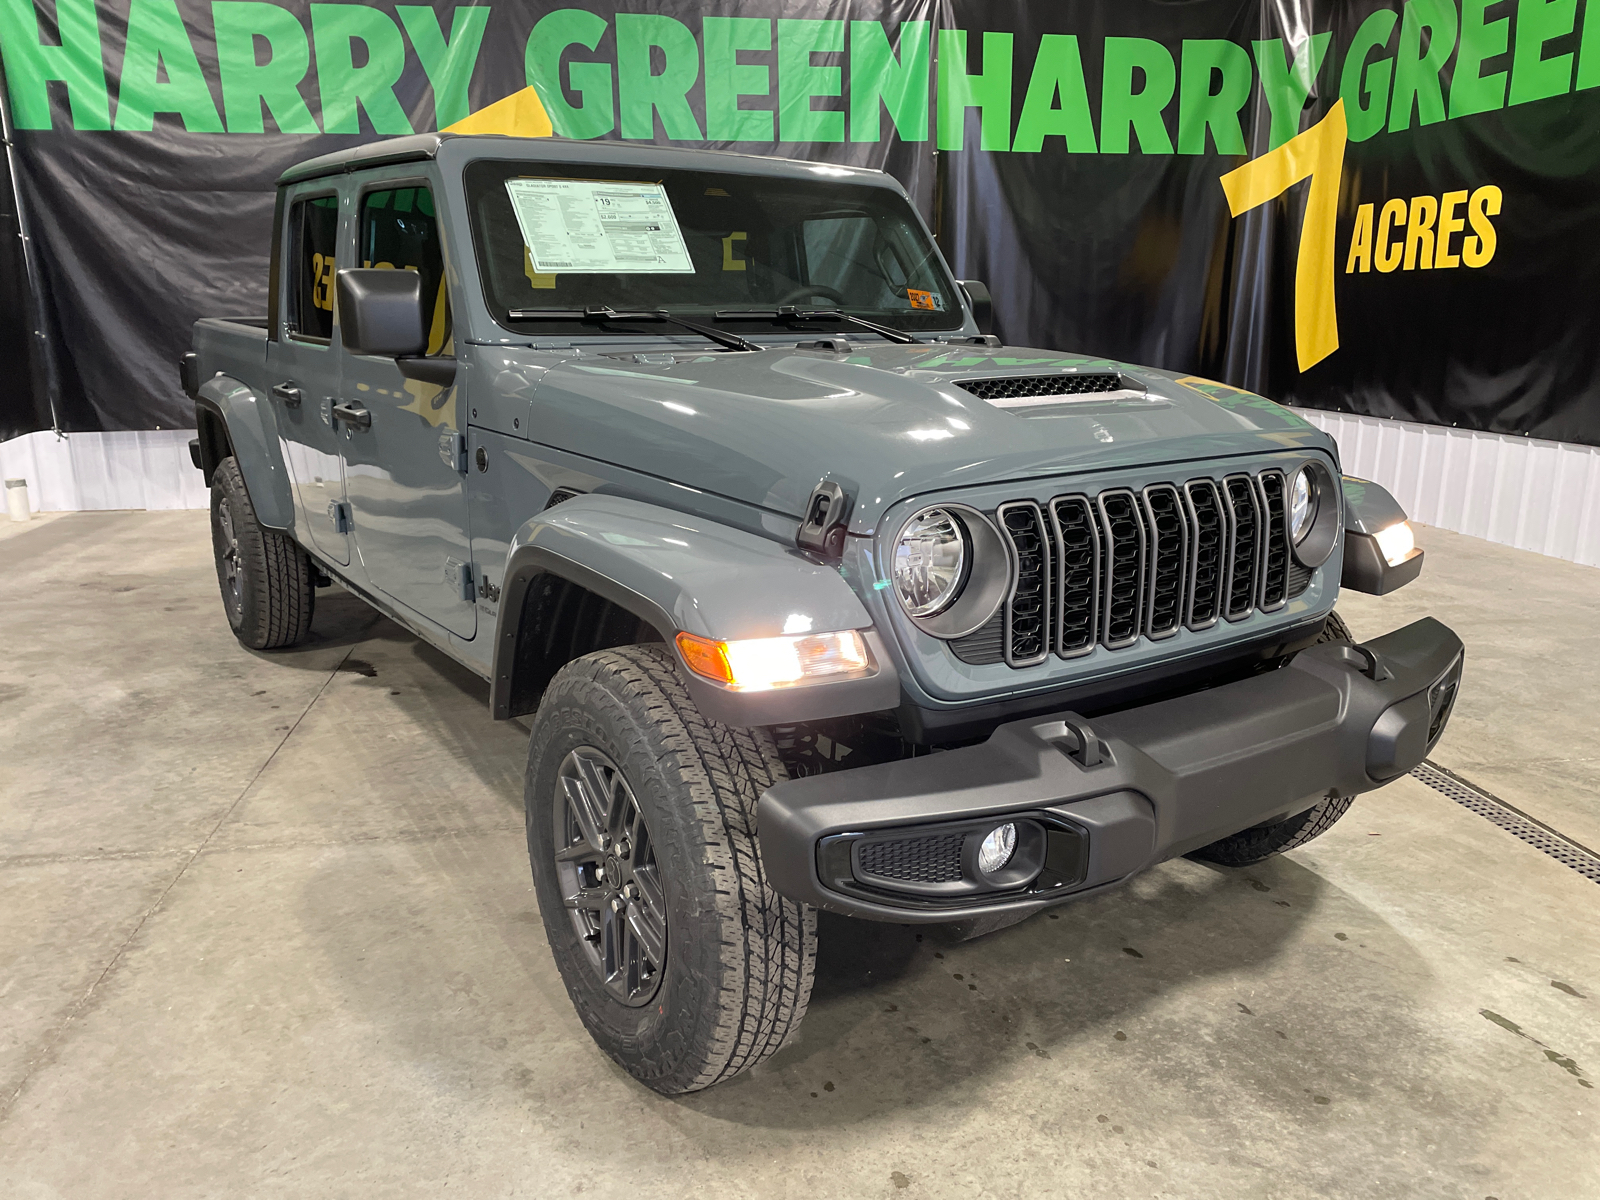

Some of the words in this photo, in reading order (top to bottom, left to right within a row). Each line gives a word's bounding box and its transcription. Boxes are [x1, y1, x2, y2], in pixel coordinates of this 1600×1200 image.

[0, 0, 491, 135] HARRY
[525, 8, 931, 143] GREEN
[938, 29, 1333, 156] HARRY
[600, 198, 611, 206] 19
[1219, 97, 1348, 373] 7
[1346, 185, 1503, 273] ACRES
